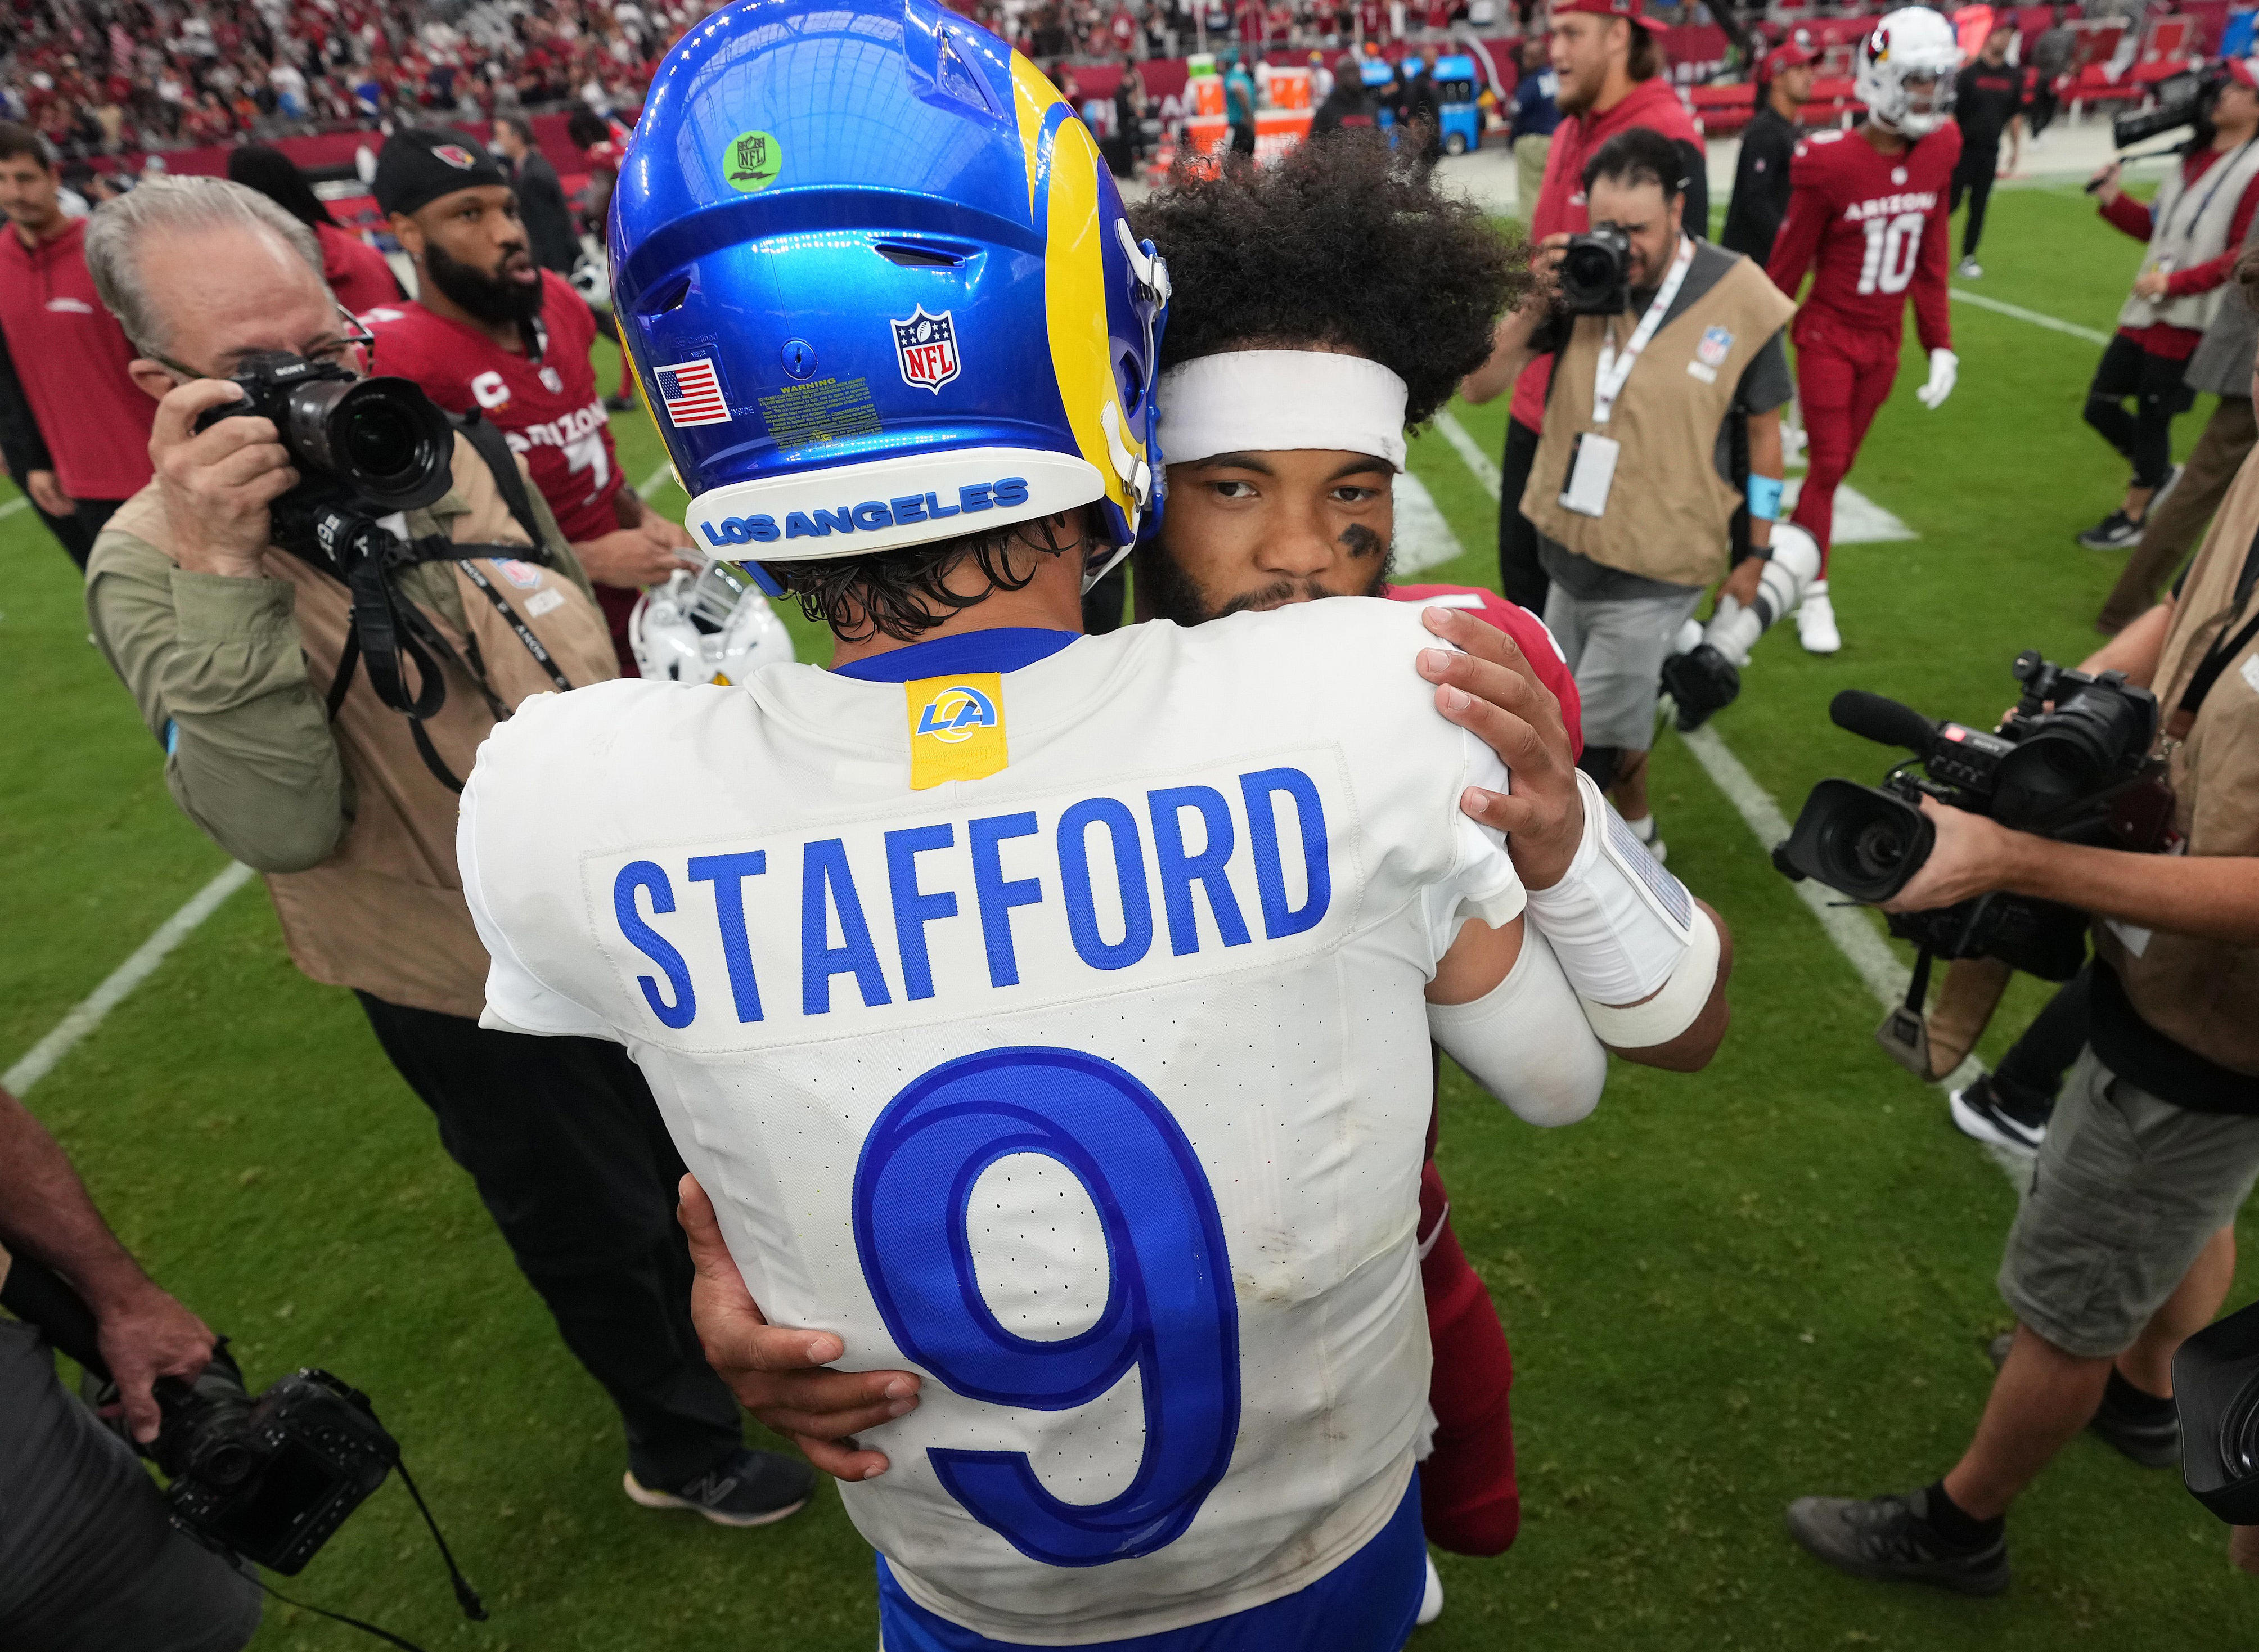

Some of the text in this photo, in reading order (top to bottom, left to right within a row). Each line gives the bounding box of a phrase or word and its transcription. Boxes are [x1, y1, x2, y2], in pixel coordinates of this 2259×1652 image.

[741, 150, 763, 166] NFL
[1857, 213, 1926, 295] 10
[471, 371, 511, 409] C
[780, 377, 836, 393] WARNING
[906, 344, 953, 380] NFL
[562, 429, 611, 490] 7
[700, 476, 1029, 546] LOS ANGELES
[916, 686, 998, 737] LA
[613, 766, 1332, 1029] STAFFORD
[852, 1045, 1241, 1568] 9
